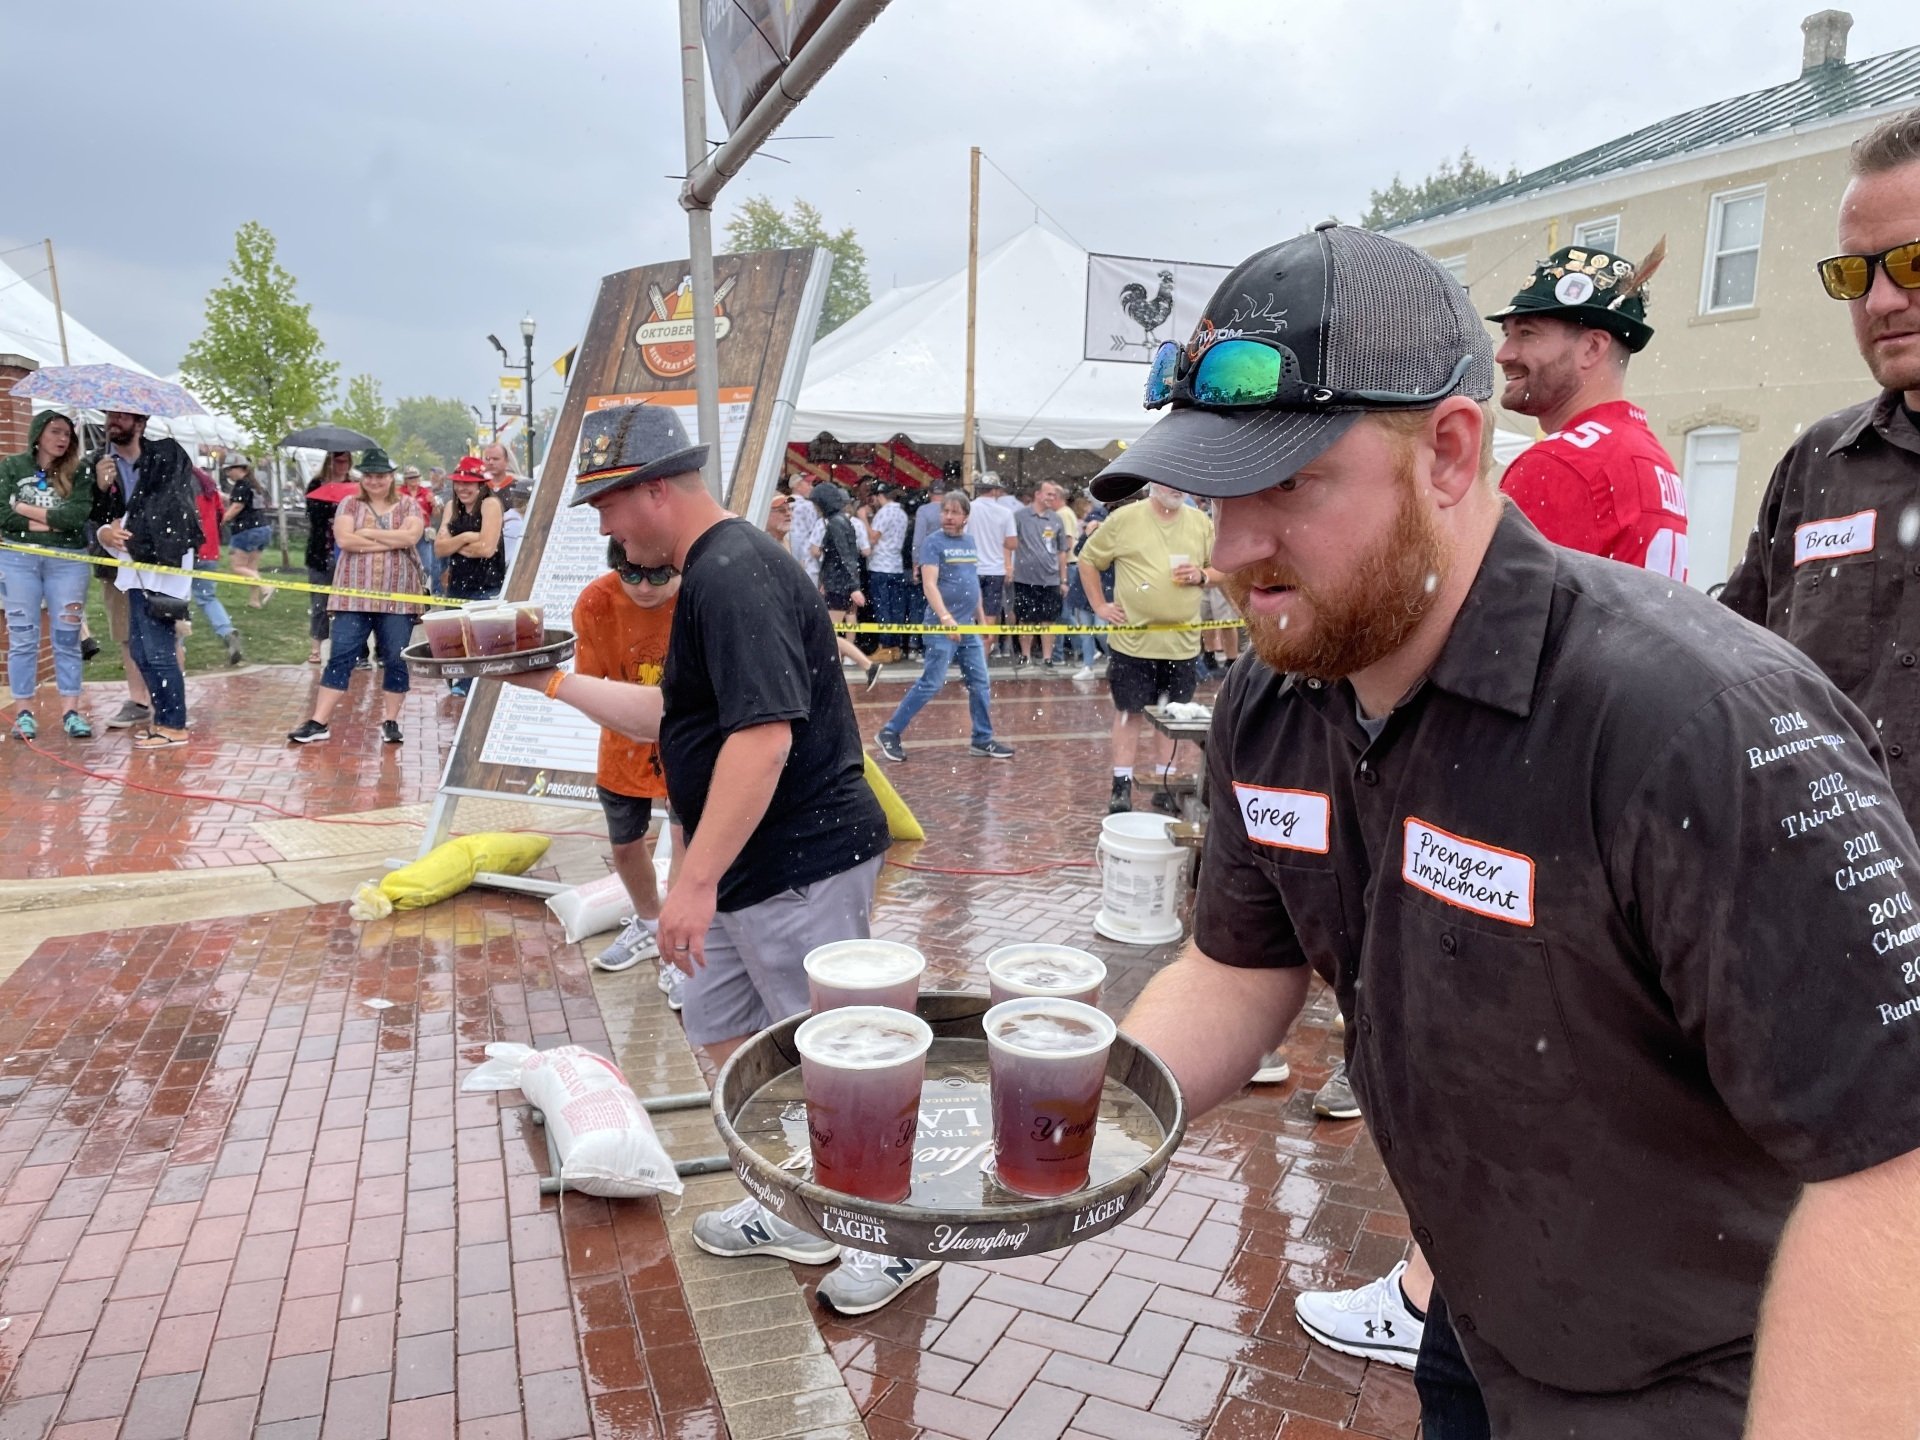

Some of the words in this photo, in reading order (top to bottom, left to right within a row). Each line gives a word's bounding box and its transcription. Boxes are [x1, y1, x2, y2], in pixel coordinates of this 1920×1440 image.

[640, 323, 723, 339] OKTOBERT
[1806, 526, 1855, 549] Brad
[441, 666, 465, 675] LAGER
[528, 656, 550, 667] LAGER
[1769, 711, 1808, 736] 2014
[1746, 733, 1846, 769] Runner-ups
[546, 782, 586, 798] PRECISION
[1808, 772, 1848, 802] 2012
[1246, 798, 1300, 837] Greg
[1781, 797, 1845, 840] Third
[1846, 790, 1881, 812] Place
[1420, 832, 1503, 882] Prenger
[1843, 831, 1882, 863] 2011
[1411, 851, 1520, 911] Implement
[1835, 856, 1904, 892] Champs
[1868, 891, 1913, 925] 2010
[1872, 922, 1920, 955] Cham
[1901, 956, 1920, 985] 20
[920, 1096, 978, 1105] AMERICA
[738, 1161, 786, 1212] Yuengling
[822, 1212, 889, 1245] LAGER
[829, 1207, 880, 1225] TRADITIONAL
[1072, 1194, 1126, 1233] LAGER
[928, 1222, 1031, 1255] Yuengling
